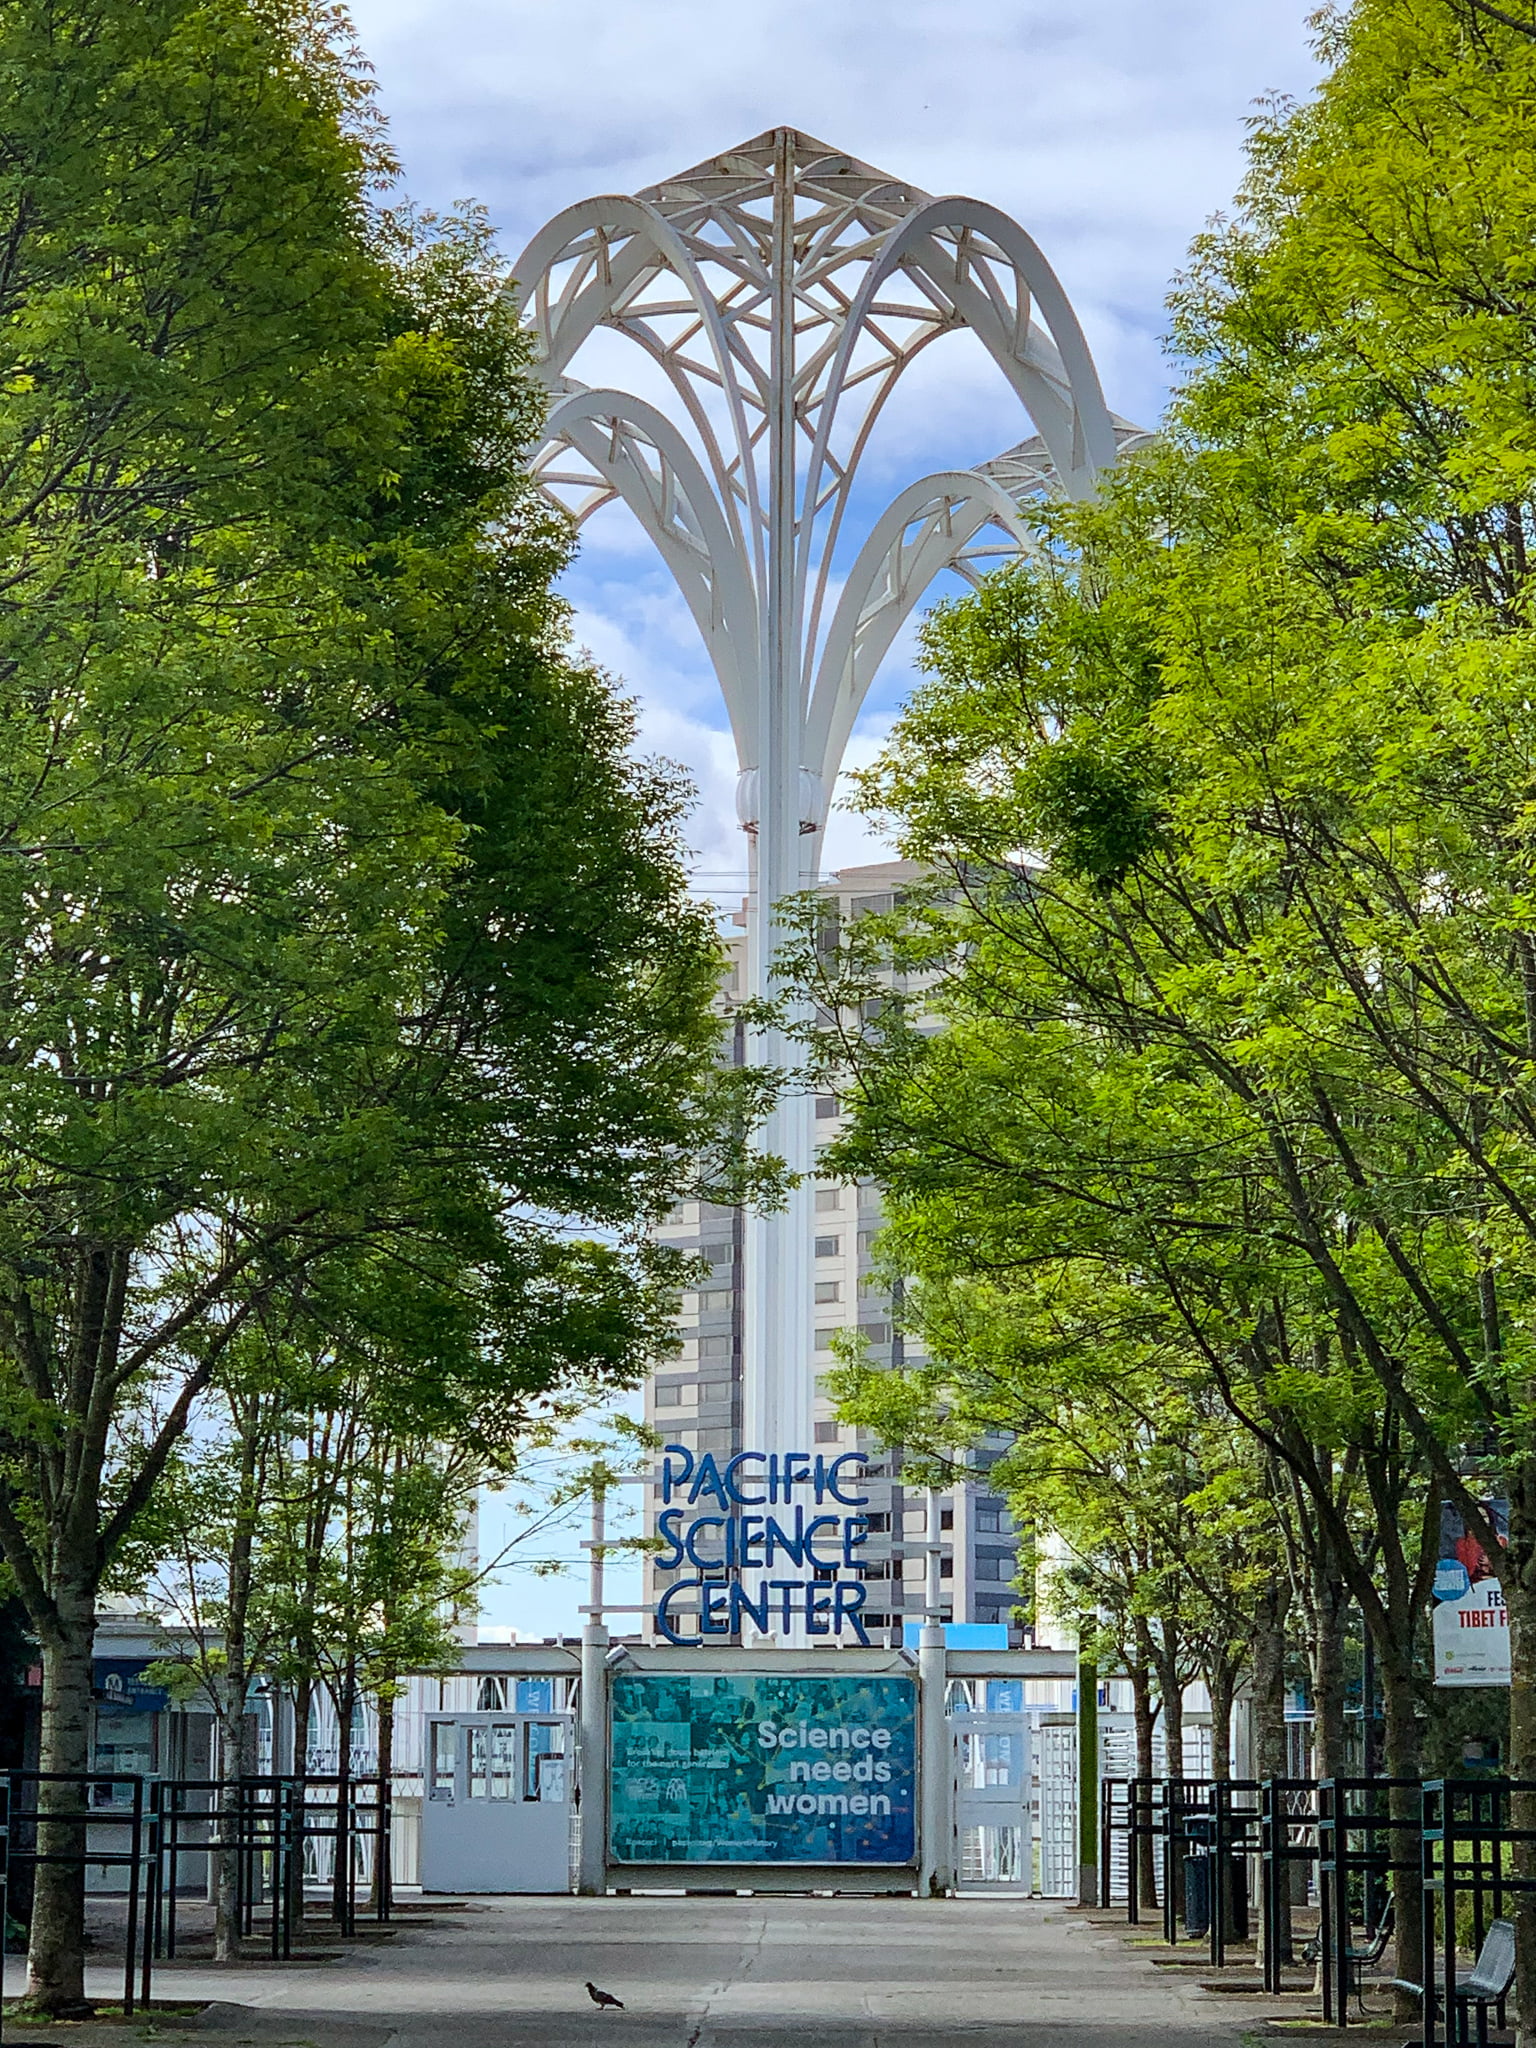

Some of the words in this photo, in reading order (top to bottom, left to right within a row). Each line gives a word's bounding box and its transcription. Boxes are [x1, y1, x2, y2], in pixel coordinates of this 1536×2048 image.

[662, 1444, 870, 1511] PACIFIC
[654, 1505, 869, 1570] SCIENCE
[656, 1578, 870, 1646] CENTER
[1458, 1610, 1495, 1628] TIBET
[757, 1720, 892, 1749] Science
[790, 1754, 892, 1782] needs
[767, 1793, 891, 1815] women
